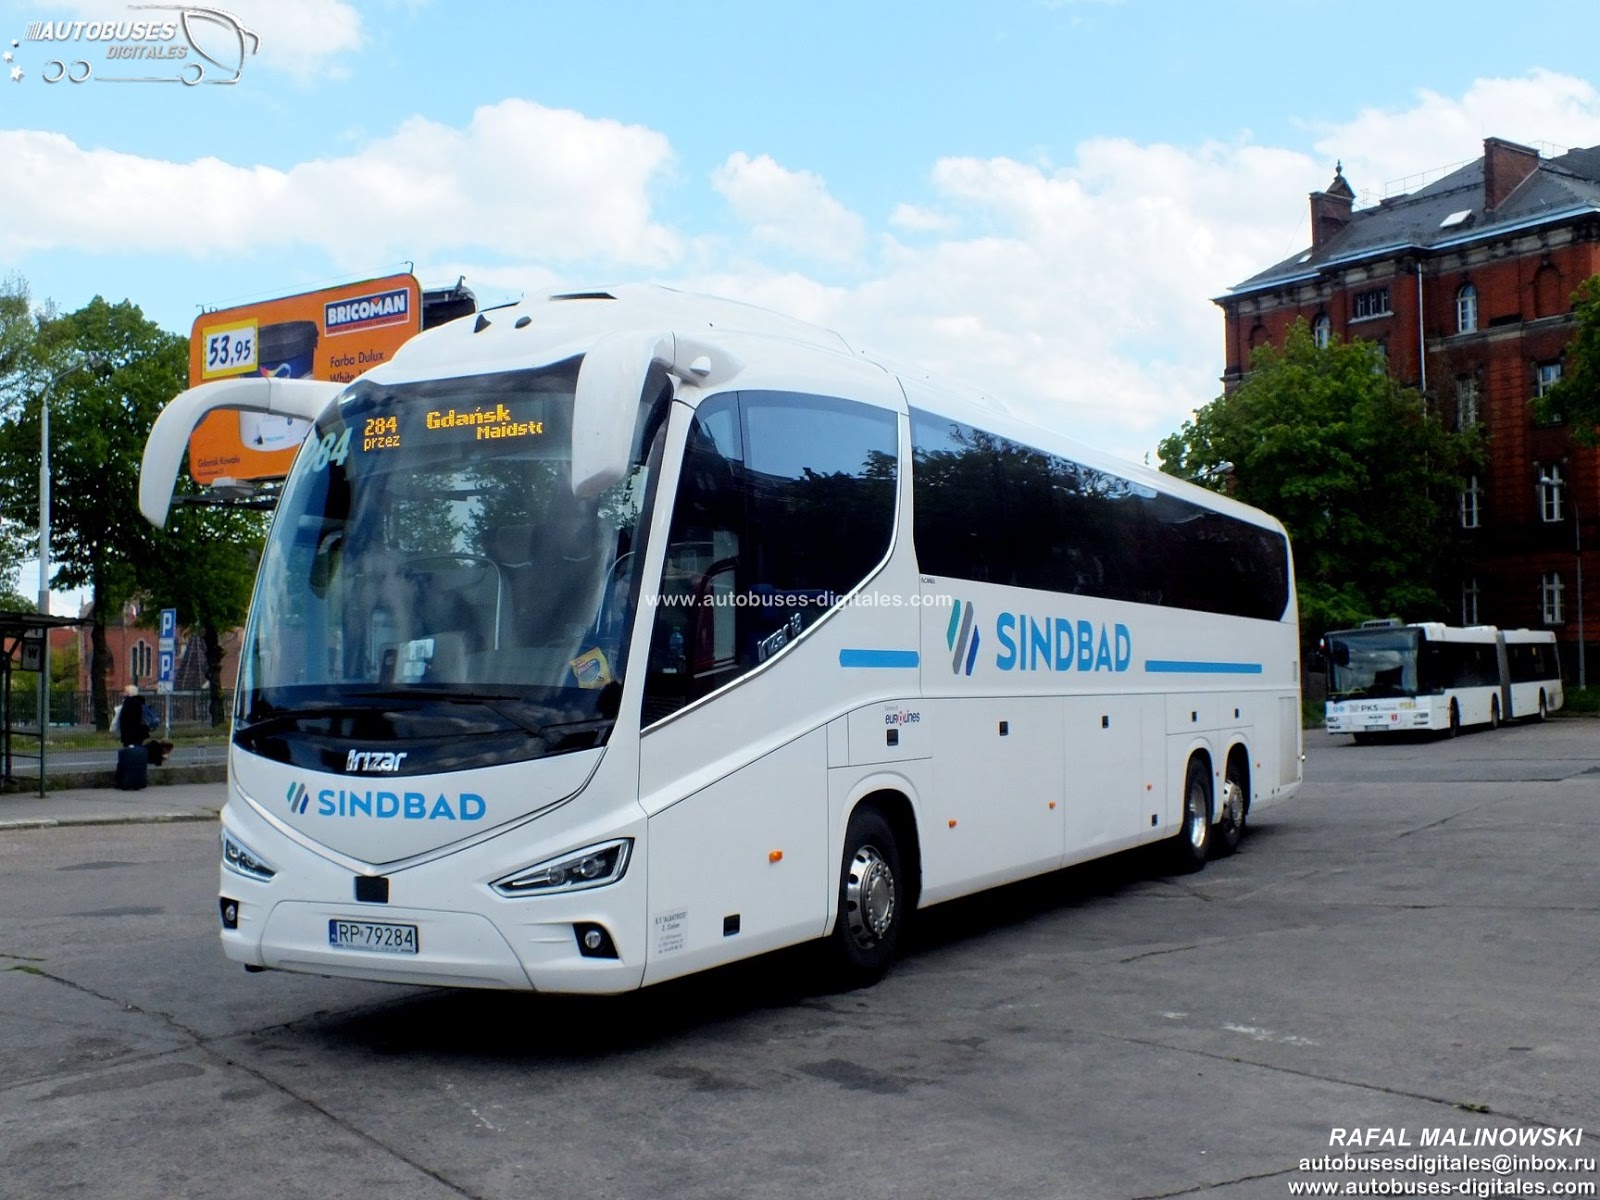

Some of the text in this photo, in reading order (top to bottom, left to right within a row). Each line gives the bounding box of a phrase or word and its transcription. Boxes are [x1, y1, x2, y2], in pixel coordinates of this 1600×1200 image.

[327, 294, 406, 325] BRICOMAN
[208, 335, 251, 367] 53,95
[330, 349, 384, 368] Farba Dulux
[364, 404, 511, 436] 284 Gdańsk
[364, 435, 401, 452] przez
[163, 612, 172, 637] P
[996, 611, 1131, 672] SINDBAD
[161, 654, 170, 679] P
[318, 789, 486, 820] SINDBAD
[339, 924, 413, 947] RP 79284
